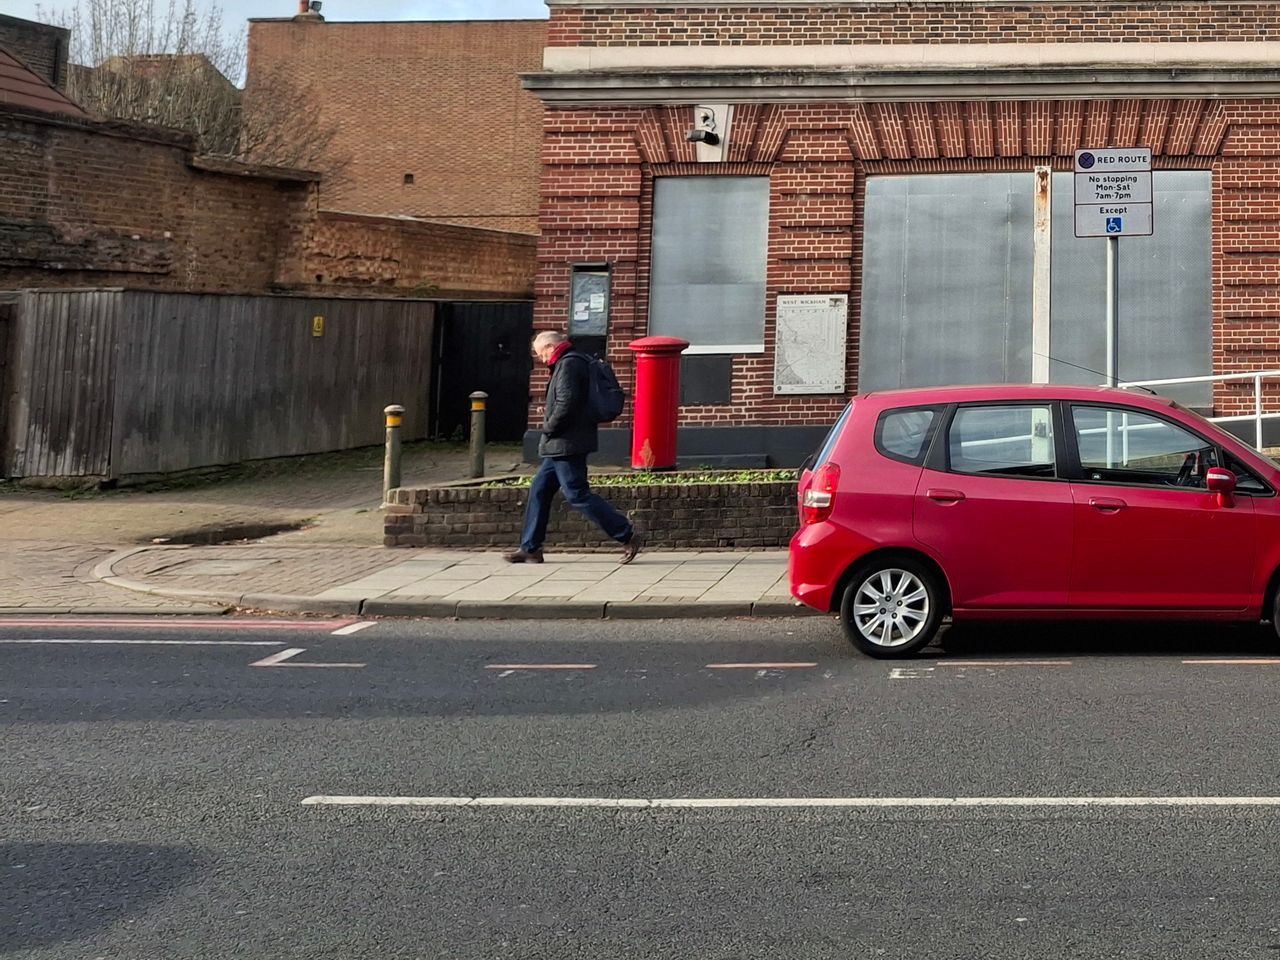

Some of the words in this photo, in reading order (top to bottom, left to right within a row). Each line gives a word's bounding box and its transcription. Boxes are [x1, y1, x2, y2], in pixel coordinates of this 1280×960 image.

[1097, 156, 1115, 164] RED
[1118, 155, 1147, 163] ROUTE
[1102, 175, 1138, 183] stopping
[1094, 192, 1131, 200] 7am-7pm
